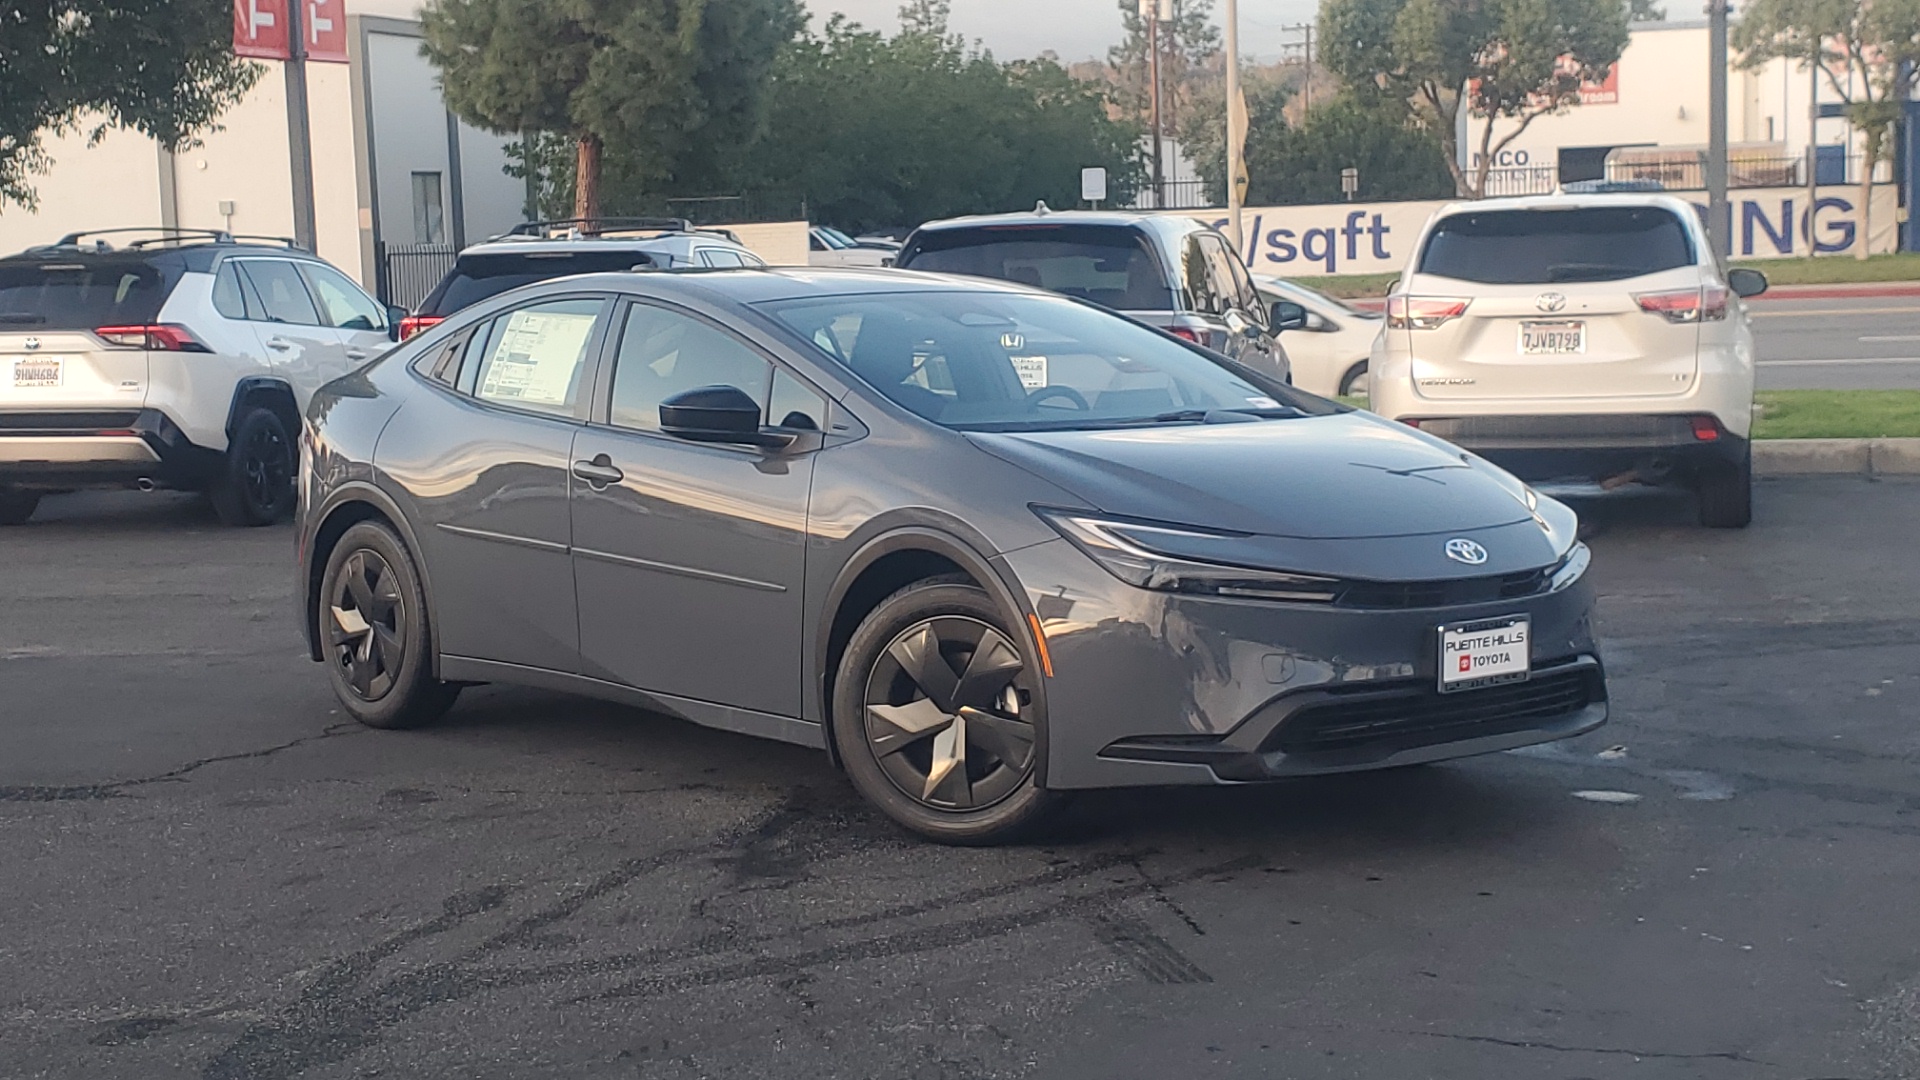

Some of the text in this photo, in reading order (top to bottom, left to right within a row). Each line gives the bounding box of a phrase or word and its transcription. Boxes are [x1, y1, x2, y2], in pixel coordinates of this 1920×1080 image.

[1446, 632, 1524, 653] PUENTE HILLS
[1473, 652, 1511, 667] TOYOTA
